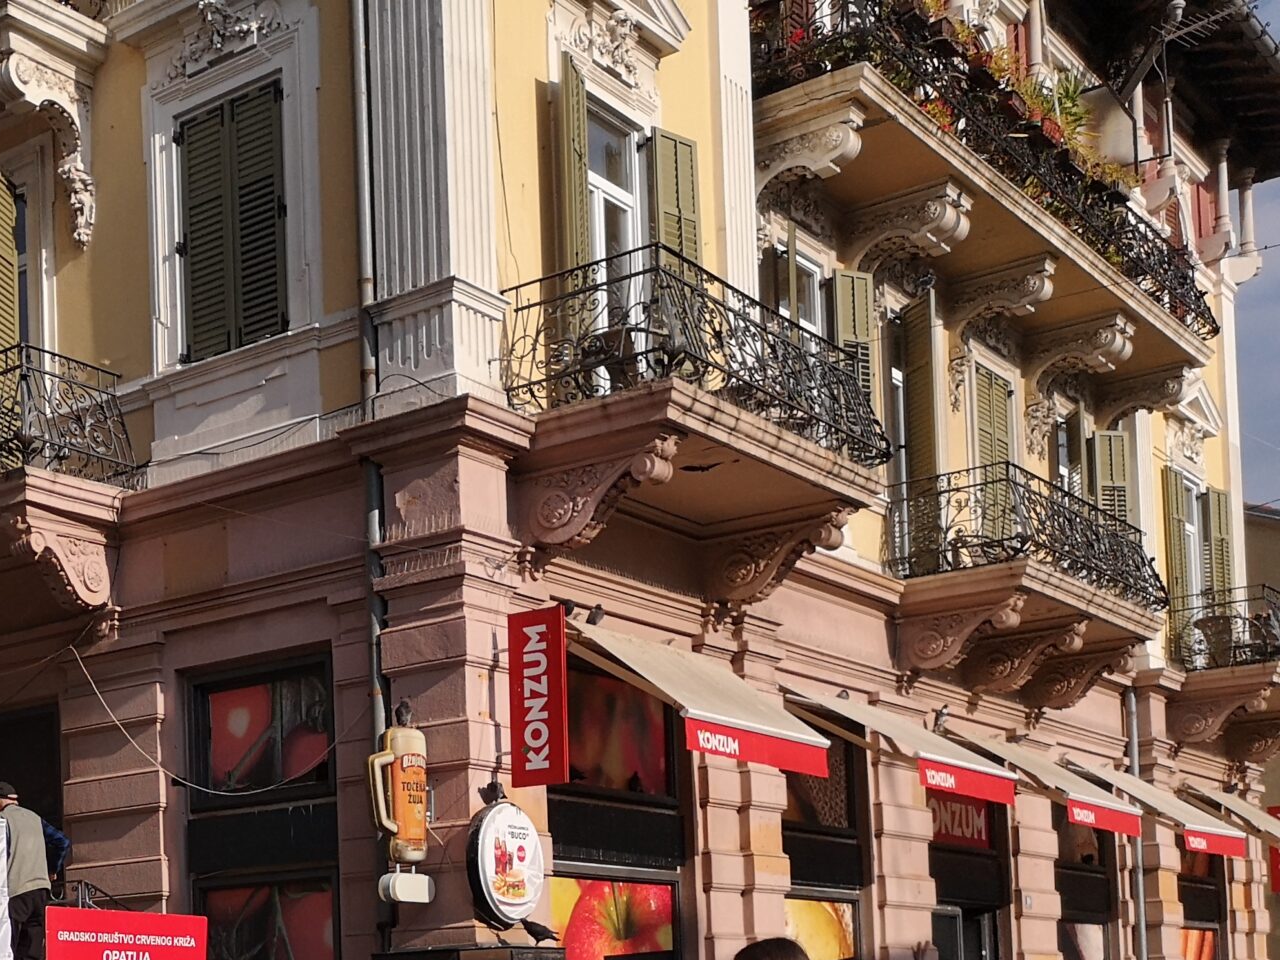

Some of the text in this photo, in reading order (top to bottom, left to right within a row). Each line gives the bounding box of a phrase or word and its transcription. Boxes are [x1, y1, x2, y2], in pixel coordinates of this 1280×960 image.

[522, 624, 550, 771] KONZUM
[697, 729, 739, 755] KONZUM
[925, 768, 955, 789] KONZUM
[58, 930, 195, 947] GRADSKO DRUŠTVO CRVENOG KRIŽA
